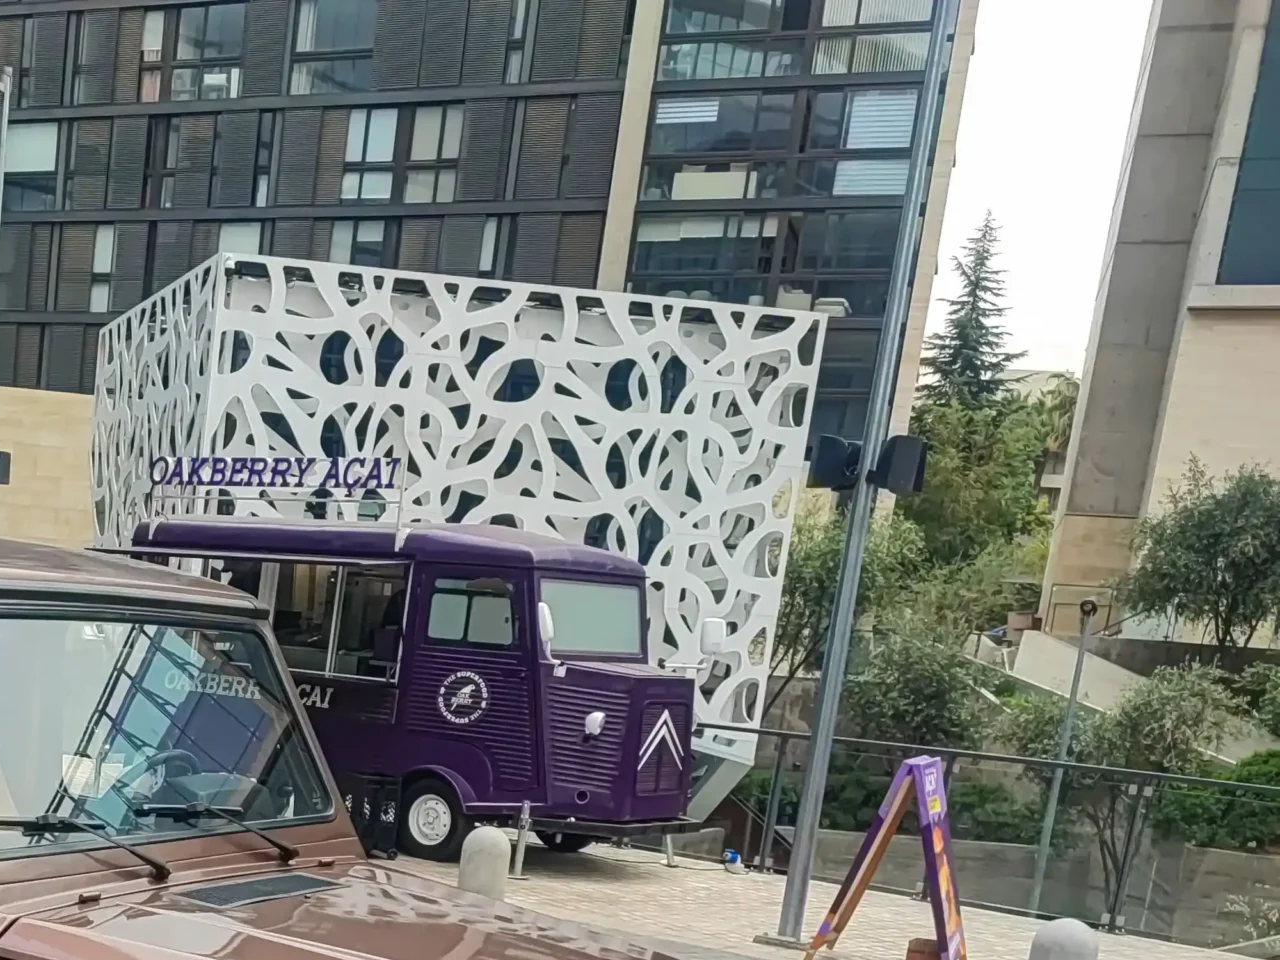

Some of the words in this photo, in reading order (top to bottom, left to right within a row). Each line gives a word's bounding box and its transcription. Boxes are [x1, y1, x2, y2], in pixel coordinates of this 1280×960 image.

[150, 456, 318, 487] OAKBERRY
[443, 675, 456, 686] THE
[456, 671, 488, 698] SUPERFOOD
[438, 697, 469, 723] SUPERFOOD
